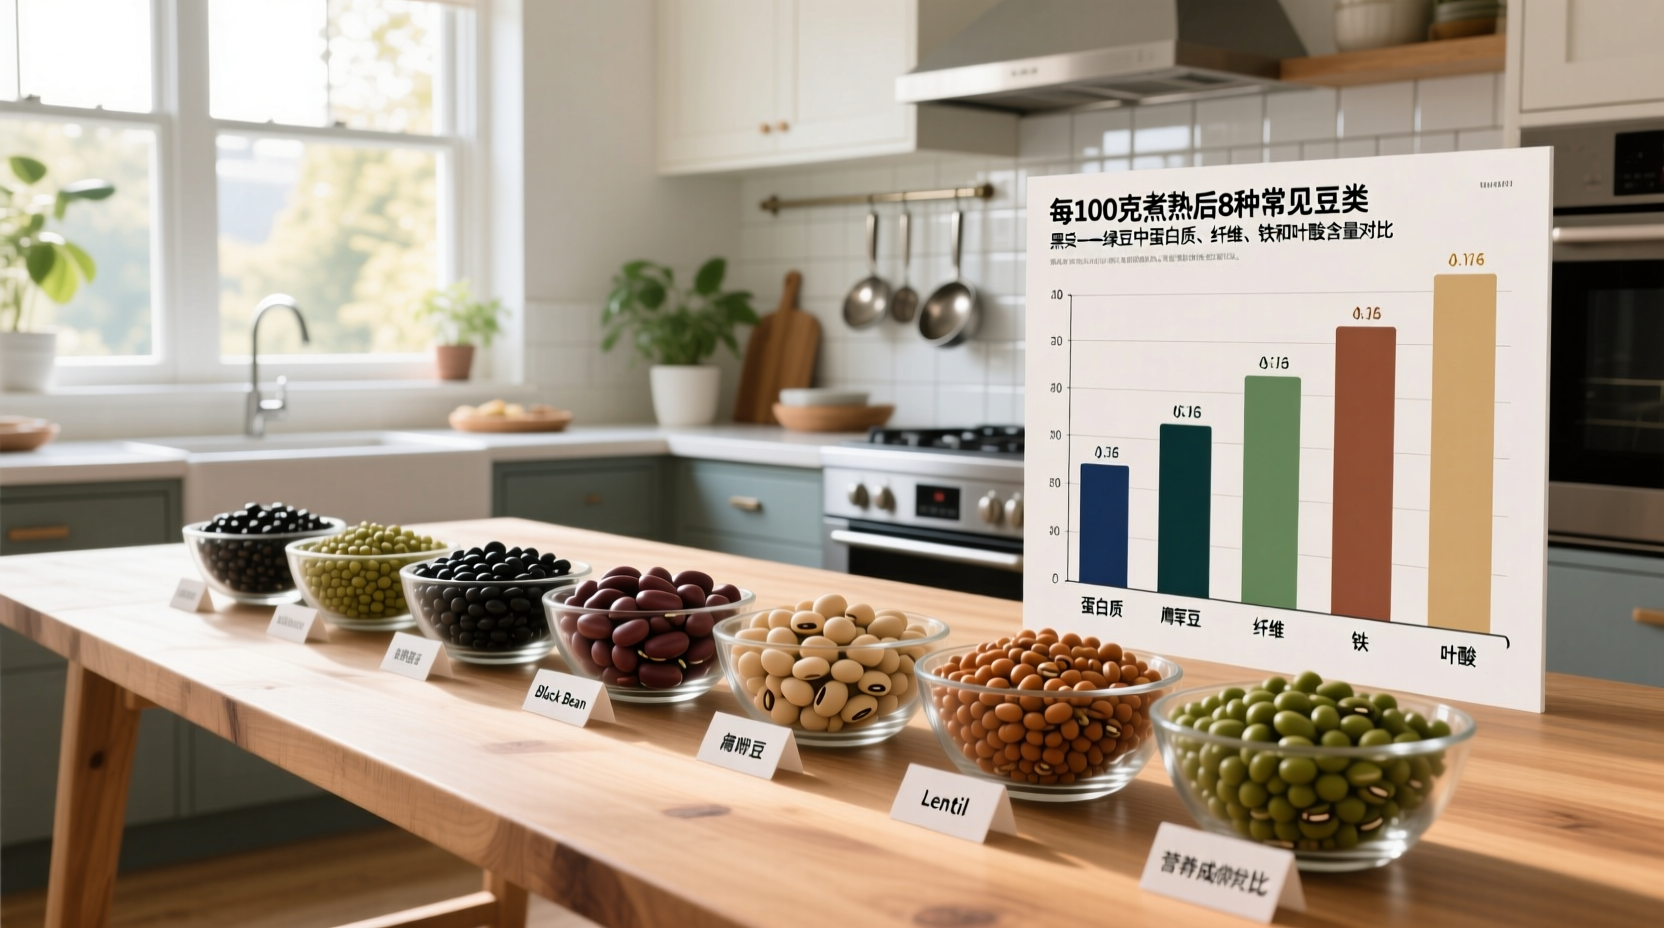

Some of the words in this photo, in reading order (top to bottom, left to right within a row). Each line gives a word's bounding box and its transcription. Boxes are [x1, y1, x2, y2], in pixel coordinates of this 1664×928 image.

[1052, 573, 1058, 583] 0
[1081, 597, 1123, 617] 蛋白质
[1253, 618, 1285, 639] 纤维
[1352, 631, 1369, 652] 铁
[1441, 645, 1477, 667] 叶酸
[535, 685, 561, 703] Black
[562, 692, 586, 710] Bean
[921, 790, 969, 816] Lentil
